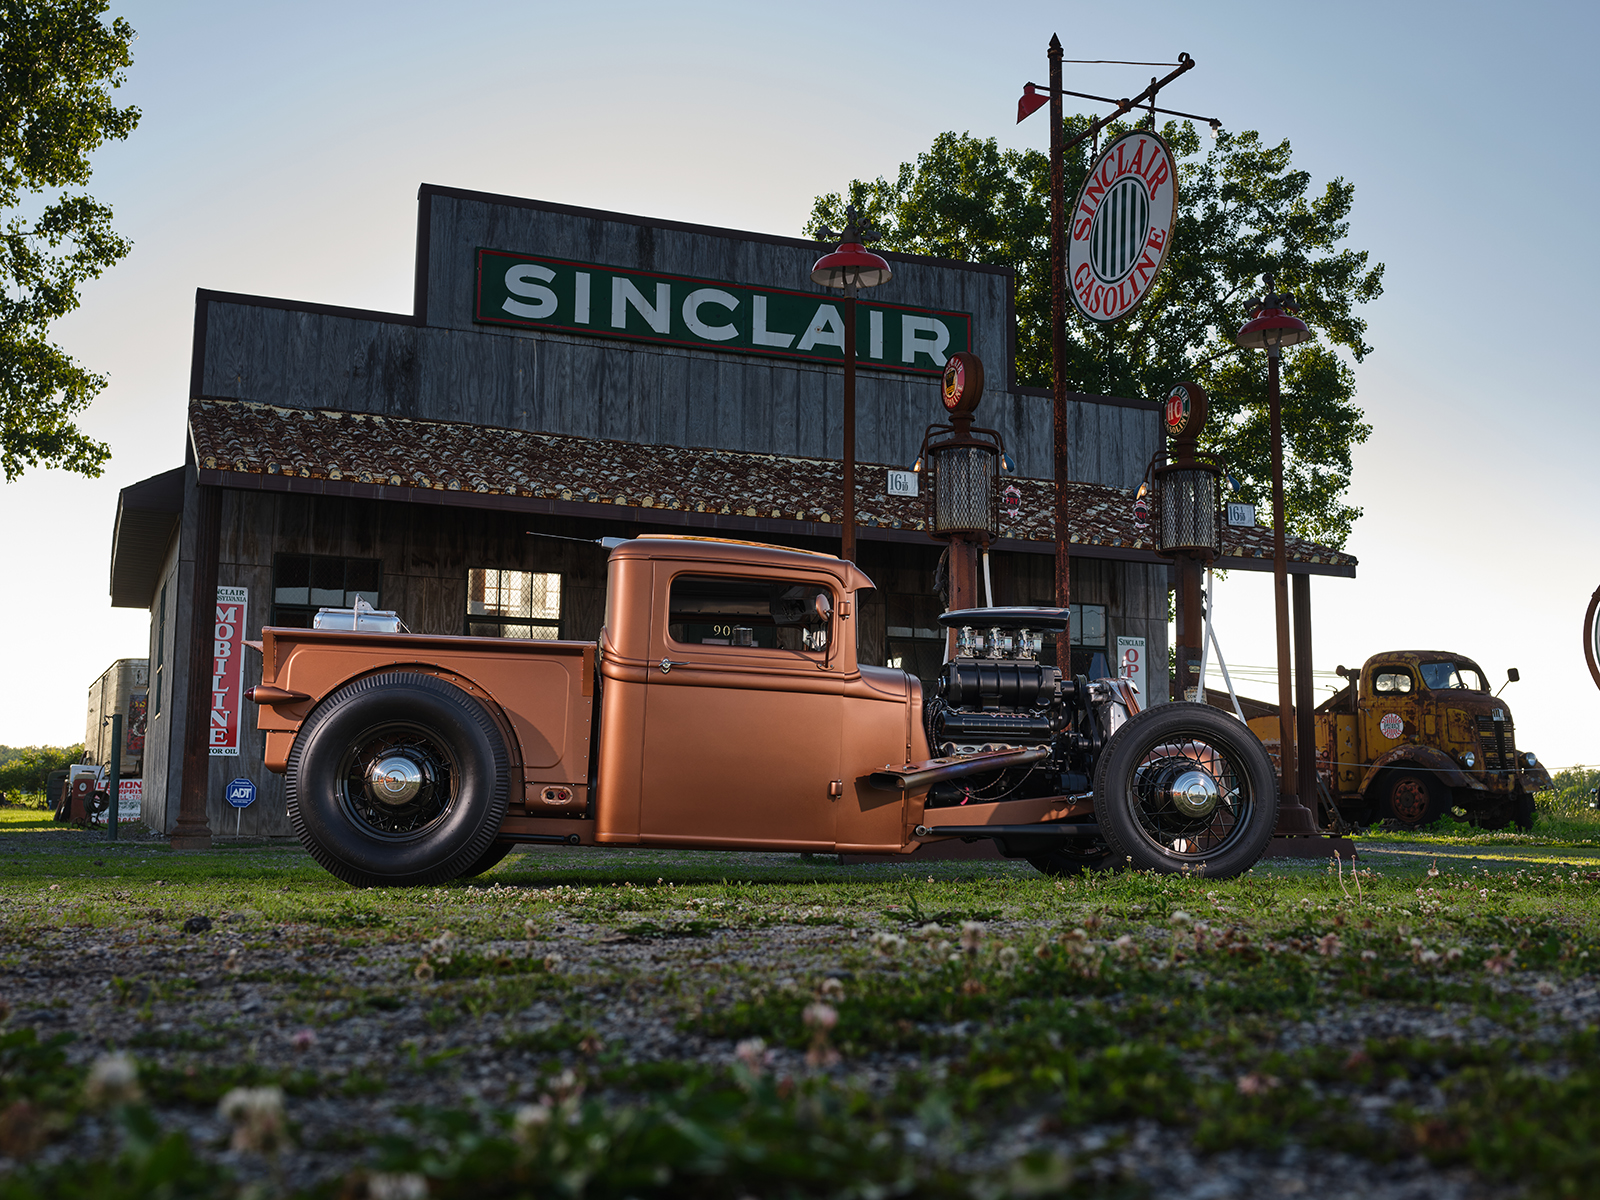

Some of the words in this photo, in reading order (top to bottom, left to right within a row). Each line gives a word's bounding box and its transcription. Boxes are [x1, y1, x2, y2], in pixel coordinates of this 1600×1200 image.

[1074, 139, 1168, 241] SINCLAIR
[501, 264, 950, 367] SINCLAIR
[1074, 227, 1166, 316] GASOLINE
[713, 625, 733, 636] 90
[1118, 638, 1145, 646] SINCLAIR
[210, 606, 238, 745] MOBILINE
[231, 788, 251, 798] ADT
